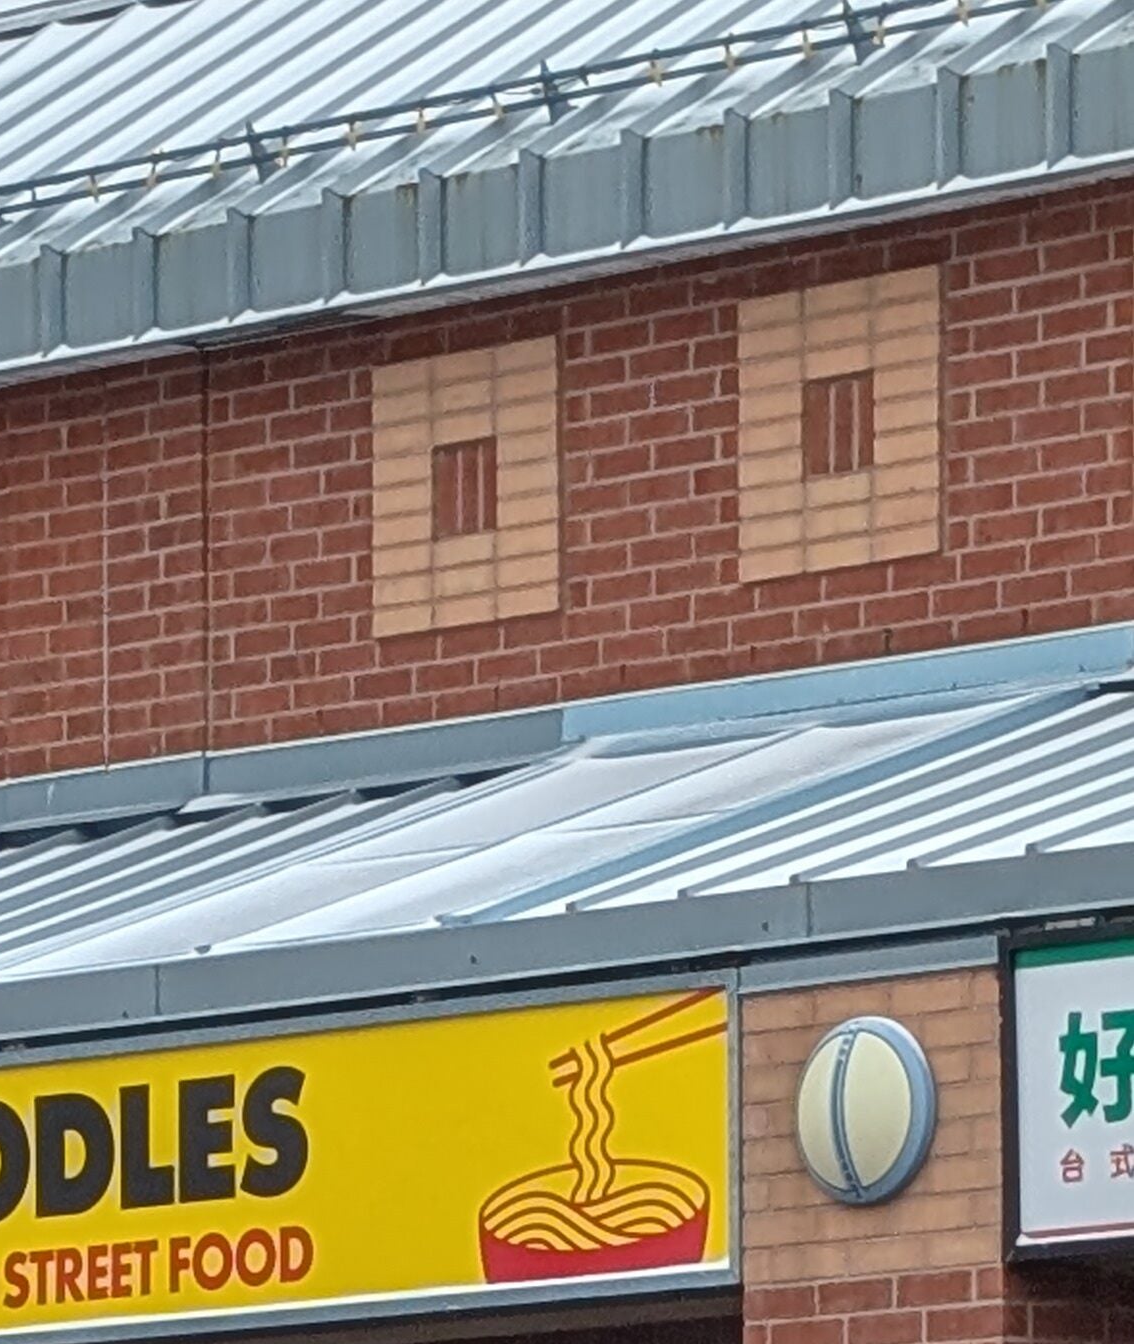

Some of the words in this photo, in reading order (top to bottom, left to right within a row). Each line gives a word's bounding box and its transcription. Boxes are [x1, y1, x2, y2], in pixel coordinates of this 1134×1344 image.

[1059, 1009, 1134, 1129] 好
[3, 1239, 158, 1309] STREET
[169, 1226, 314, 1293] FOOD
